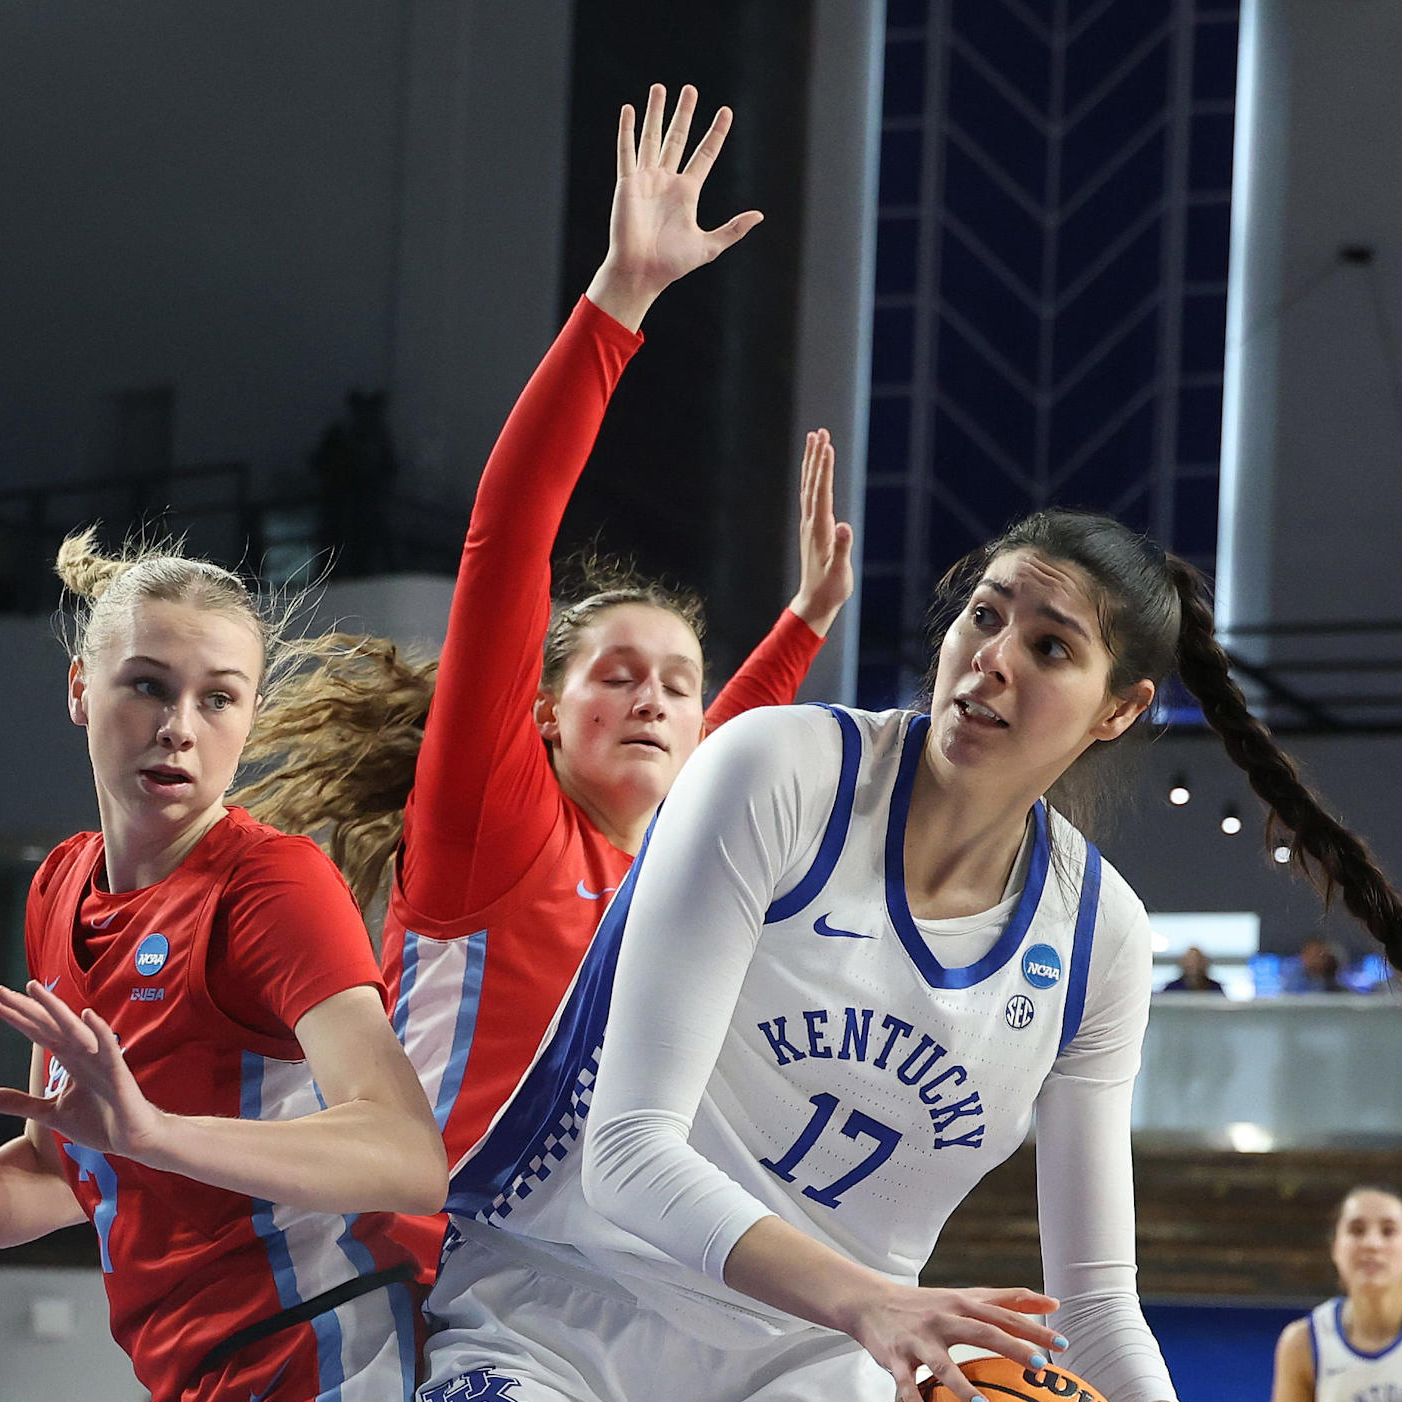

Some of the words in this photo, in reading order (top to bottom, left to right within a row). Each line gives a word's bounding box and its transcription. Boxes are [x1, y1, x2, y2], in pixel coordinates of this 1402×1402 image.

[1027, 961, 1060, 981] NCAA
[1006, 996, 1034, 1029] SEC
[757, 1007, 985, 1150] KENTUCKY
[758, 1091, 903, 1210] 17
